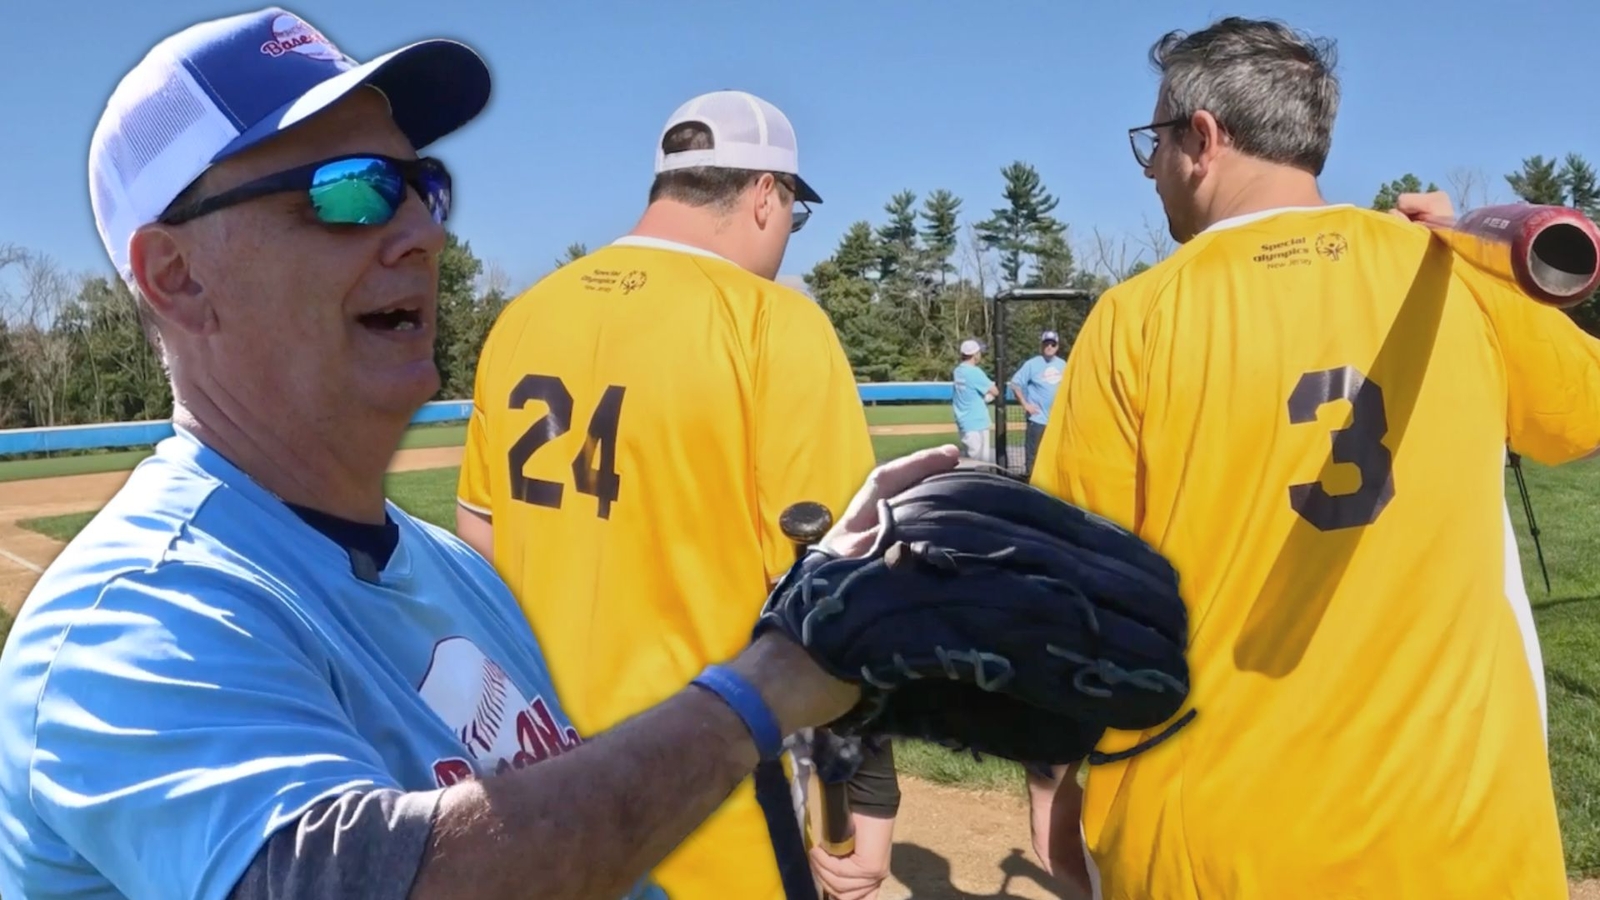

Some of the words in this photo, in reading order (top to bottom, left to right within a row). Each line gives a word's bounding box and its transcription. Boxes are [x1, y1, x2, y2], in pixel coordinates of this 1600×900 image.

[1261, 236, 1306, 251] Special
[508, 374, 627, 520] 24
[1287, 365, 1396, 532] 3
